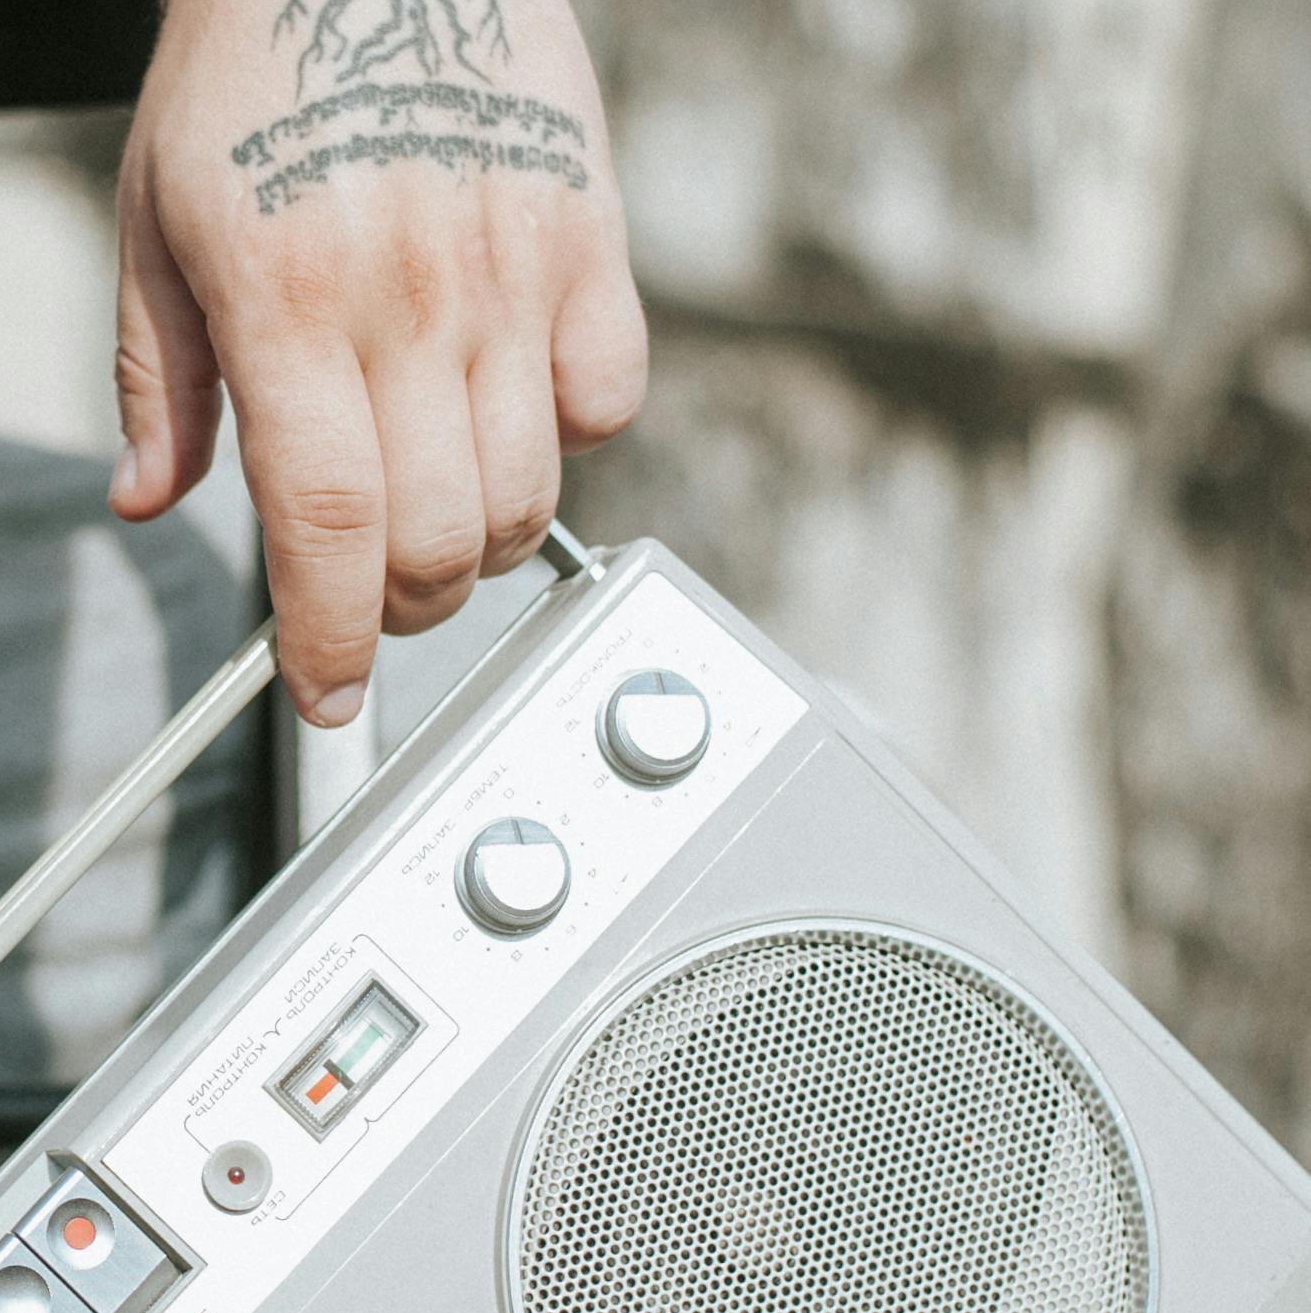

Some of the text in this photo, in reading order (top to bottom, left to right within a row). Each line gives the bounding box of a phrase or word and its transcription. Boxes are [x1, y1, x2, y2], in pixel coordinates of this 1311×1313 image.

[592, 772, 610, 790] 10
[400, 763, 508, 876] ТЕМБР ЗАПИСЬ
[559, 813, 571, 827] 2
[423, 869, 441, 886] 12
[586, 866, 598, 879] 4
[451, 925, 470, 943] 10
[509, 948, 523, 962] 8
[284, 941, 343, 1004] ЗАПИСИ
[285, 945, 358, 1021] КОНТРОЛЬ
[186, 1035, 256, 1107] ПИТАНИЯ
[194, 1041, 268, 1118] КОНТРОЛЬ
[250, 1189, 287, 1228] СЕТЬ
